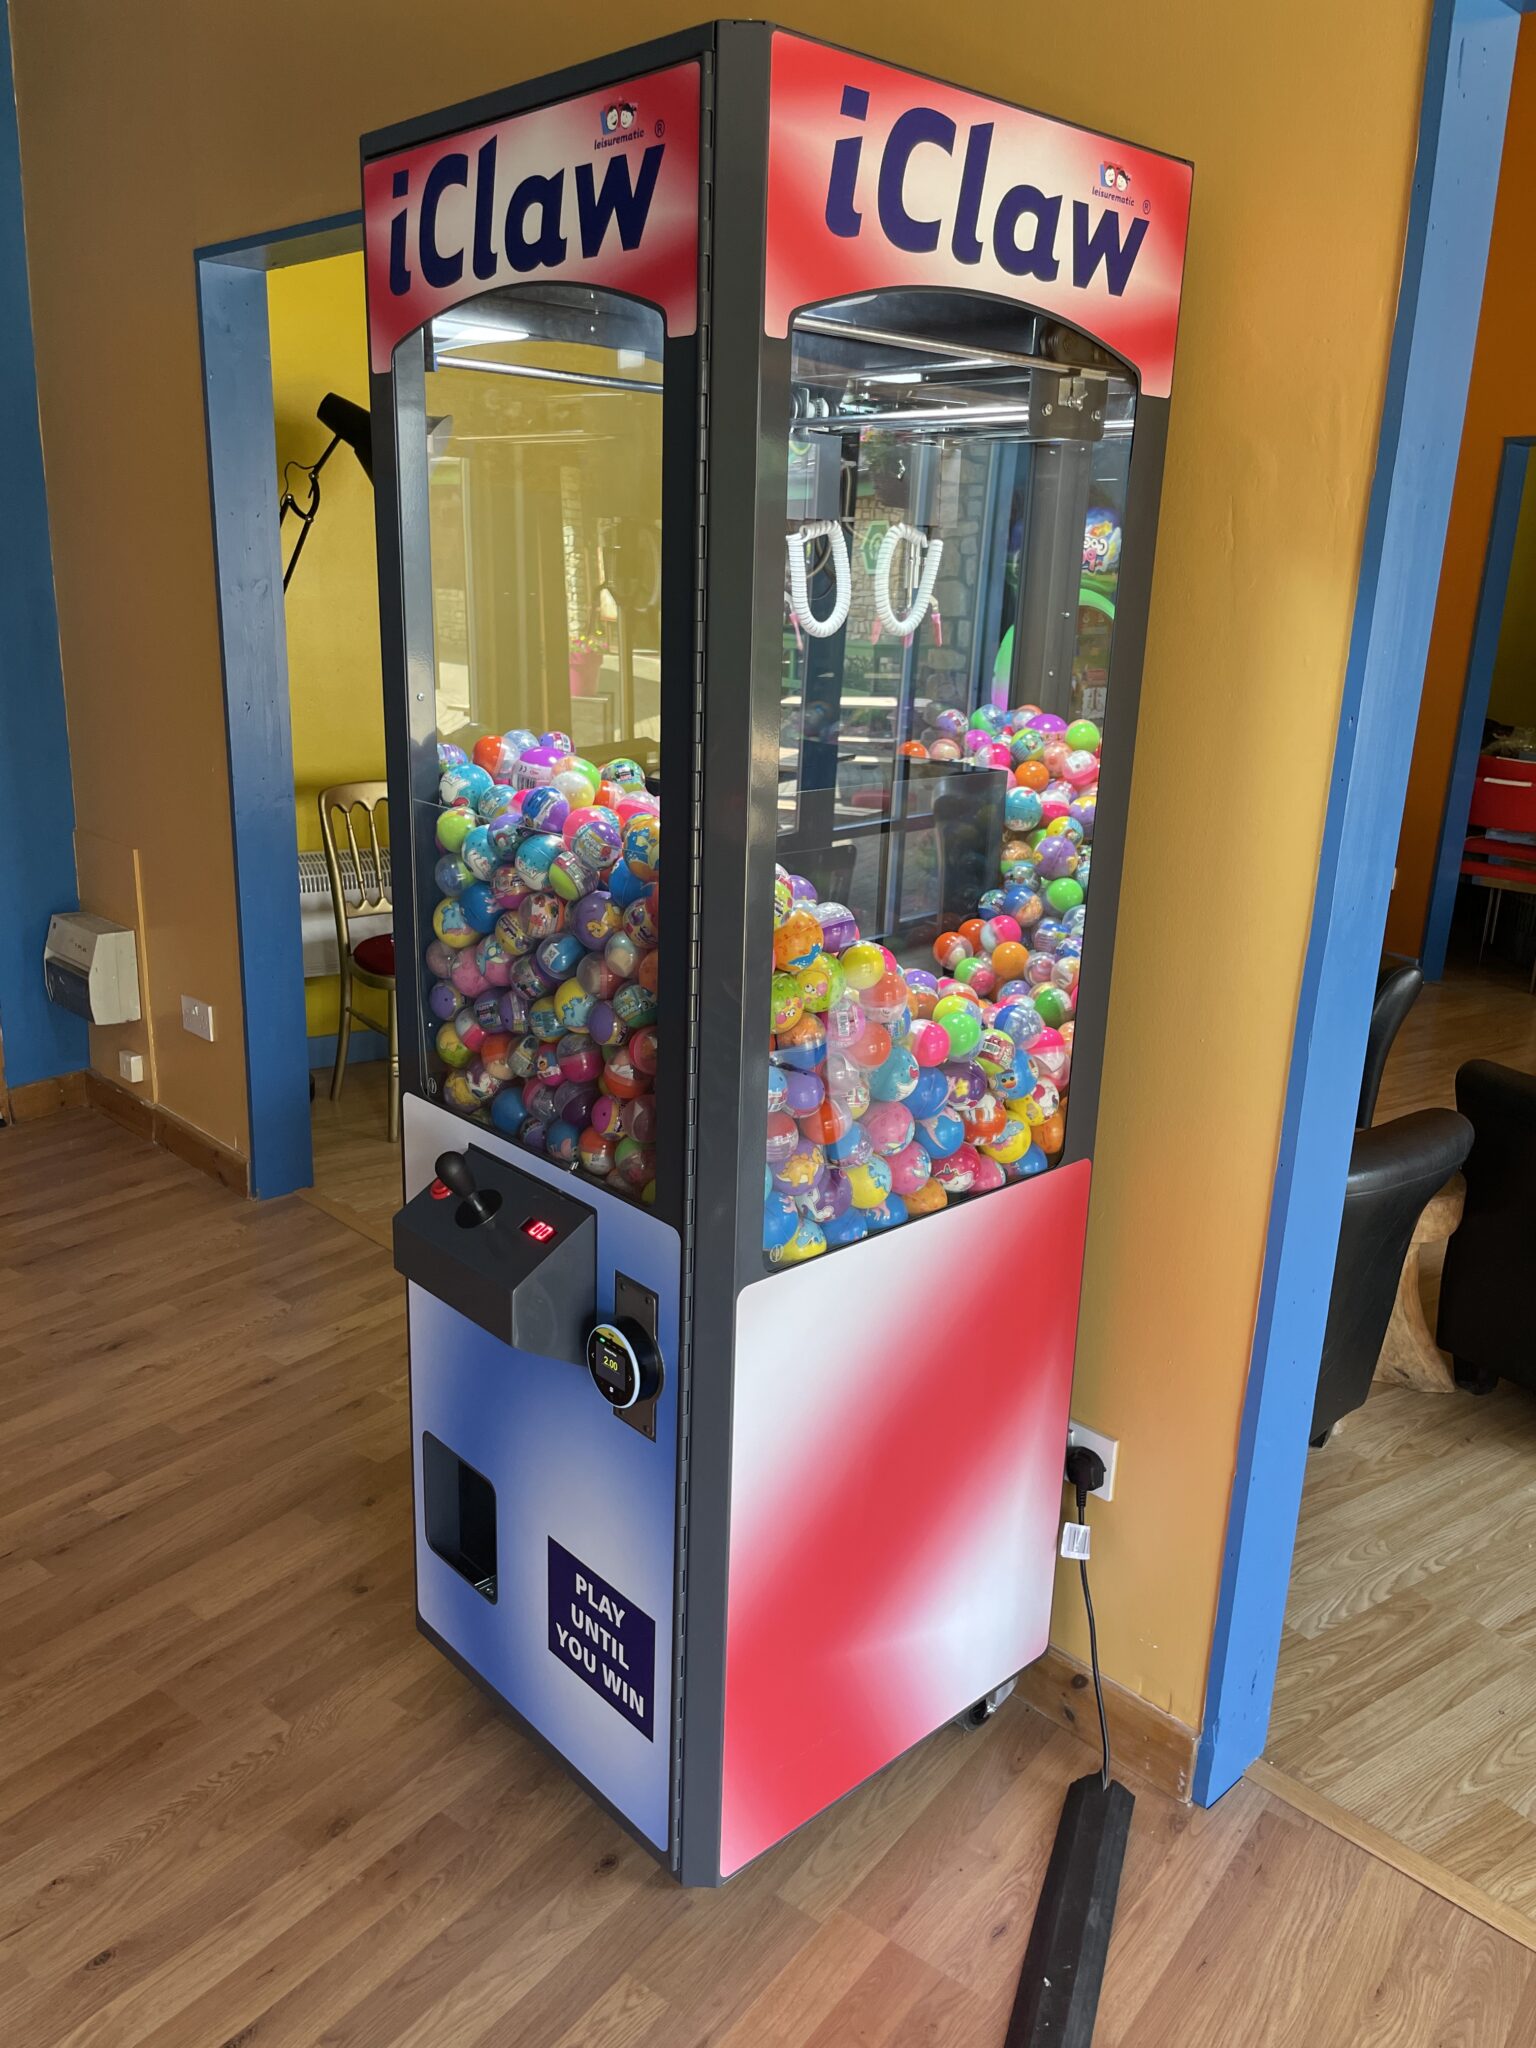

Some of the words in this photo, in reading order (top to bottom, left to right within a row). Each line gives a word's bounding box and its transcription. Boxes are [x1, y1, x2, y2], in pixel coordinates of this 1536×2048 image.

[594, 128, 645, 150] leisurematic
[389, 134, 666, 296] iClaw
[825, 84, 1150, 297] iClaw
[1091, 186, 1135, 206] leisurematic
[603, 1355, 618, 1371] 2.00
[575, 1572, 625, 1629] PLAY
[571, 1602, 629, 1671] UNTIL
[556, 1622, 596, 1674] YOU
[602, 1662, 644, 1718] WIN
